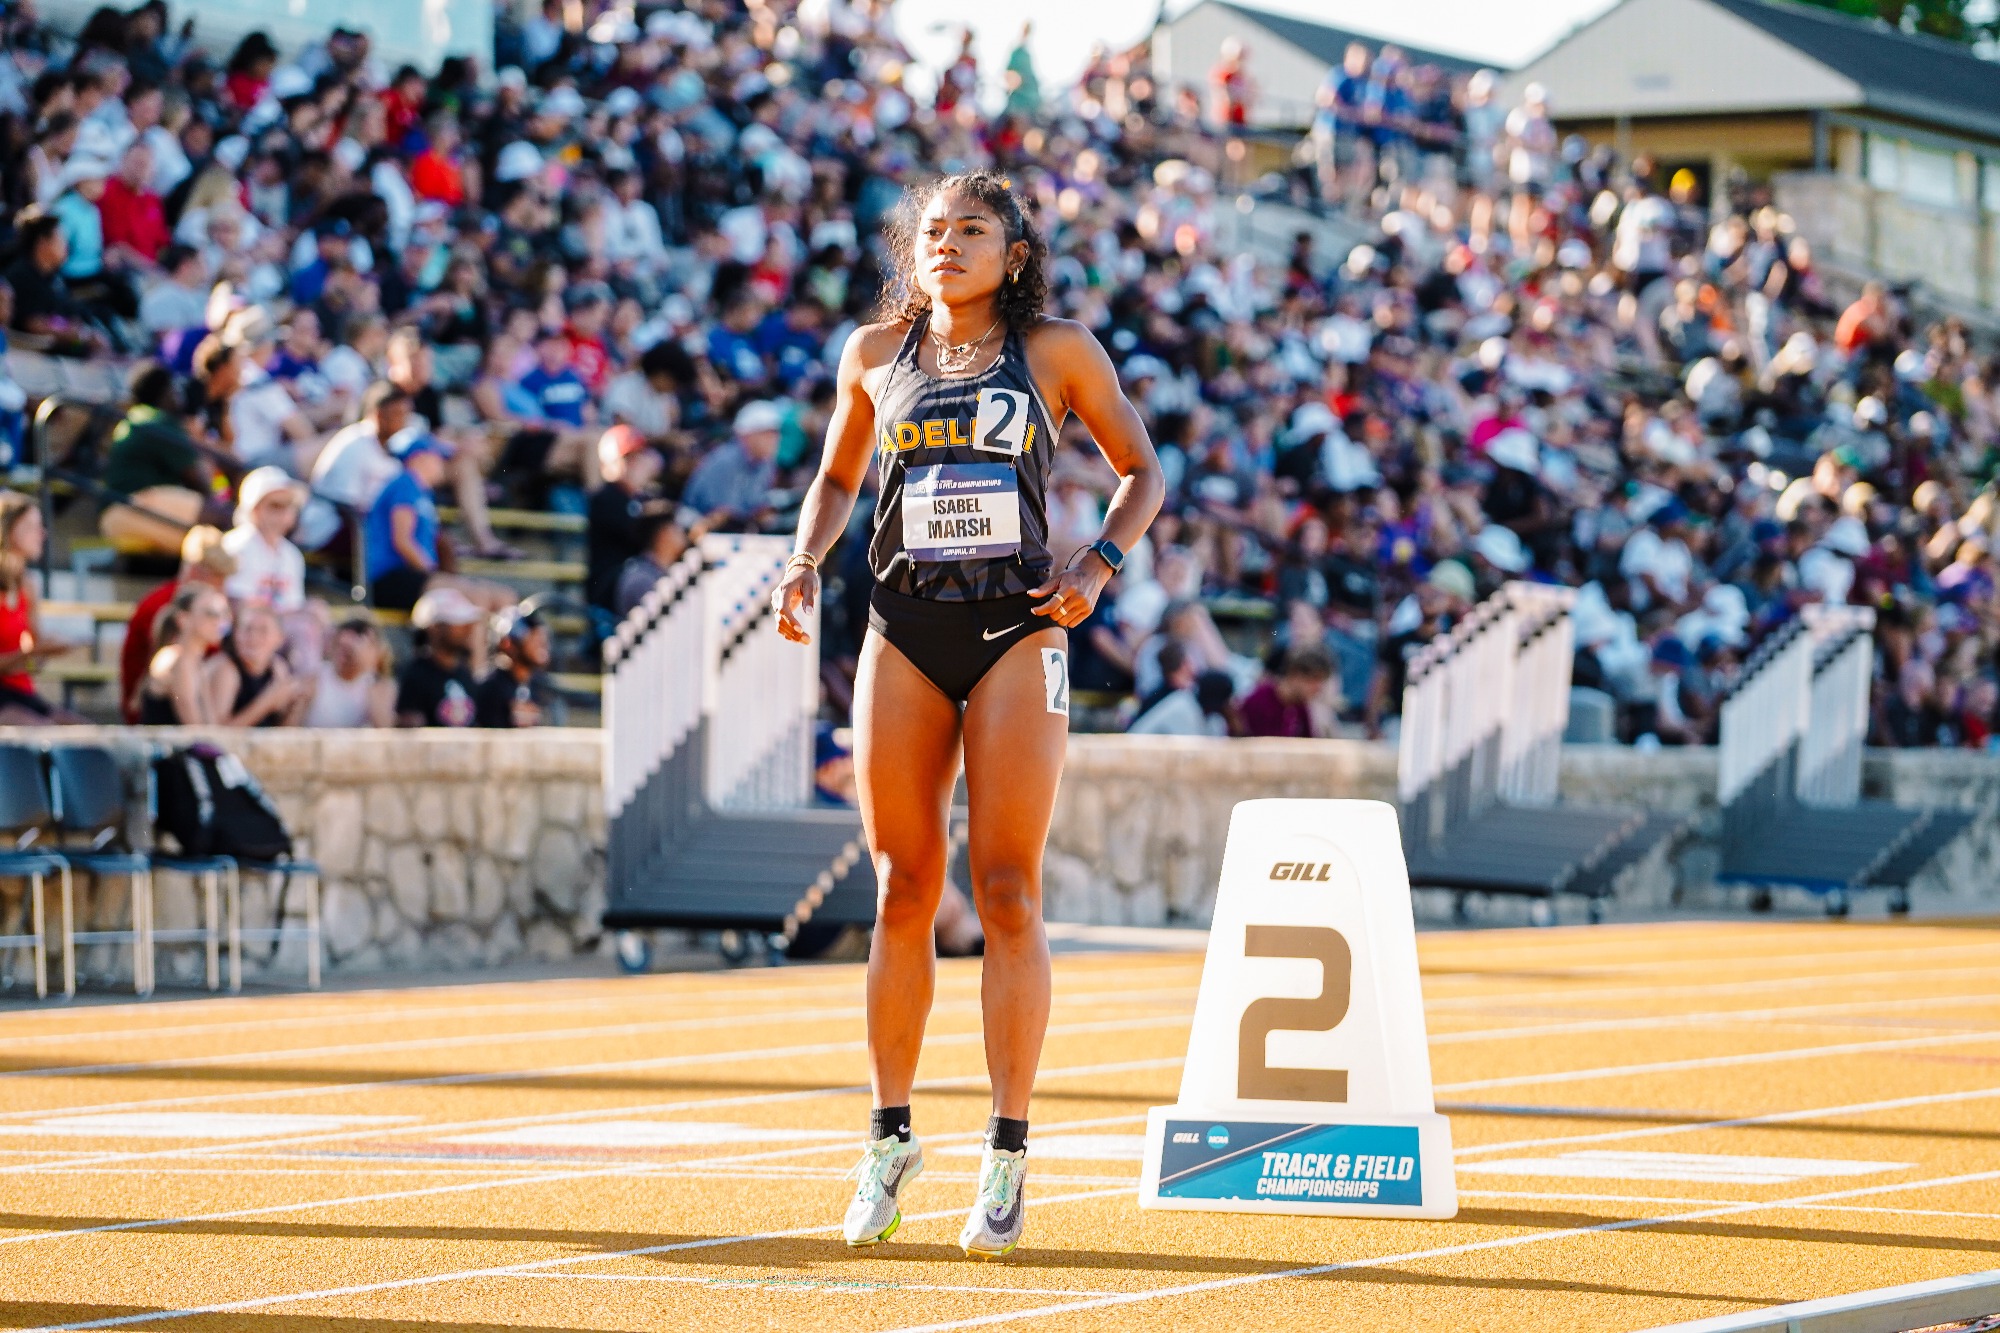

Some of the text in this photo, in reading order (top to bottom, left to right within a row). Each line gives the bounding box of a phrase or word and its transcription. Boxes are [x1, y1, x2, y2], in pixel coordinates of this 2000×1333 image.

[983, 392, 1017, 450] 2
[881, 417, 1037, 455] ADELI
[933, 497, 983, 515] ISABEL
[927, 517, 992, 540] MARSH
[1050, 652, 1067, 712] 2
[1269, 862, 1332, 882] GILL
[1237, 924, 1352, 1103] 2
[1172, 1132, 1200, 1144] GILL
[1207, 1135, 1229, 1145] NCAA
[1261, 1151, 1415, 1181] TRACK & FIELD
[1256, 1180, 1380, 1199] CHAMPIONSHIPS
